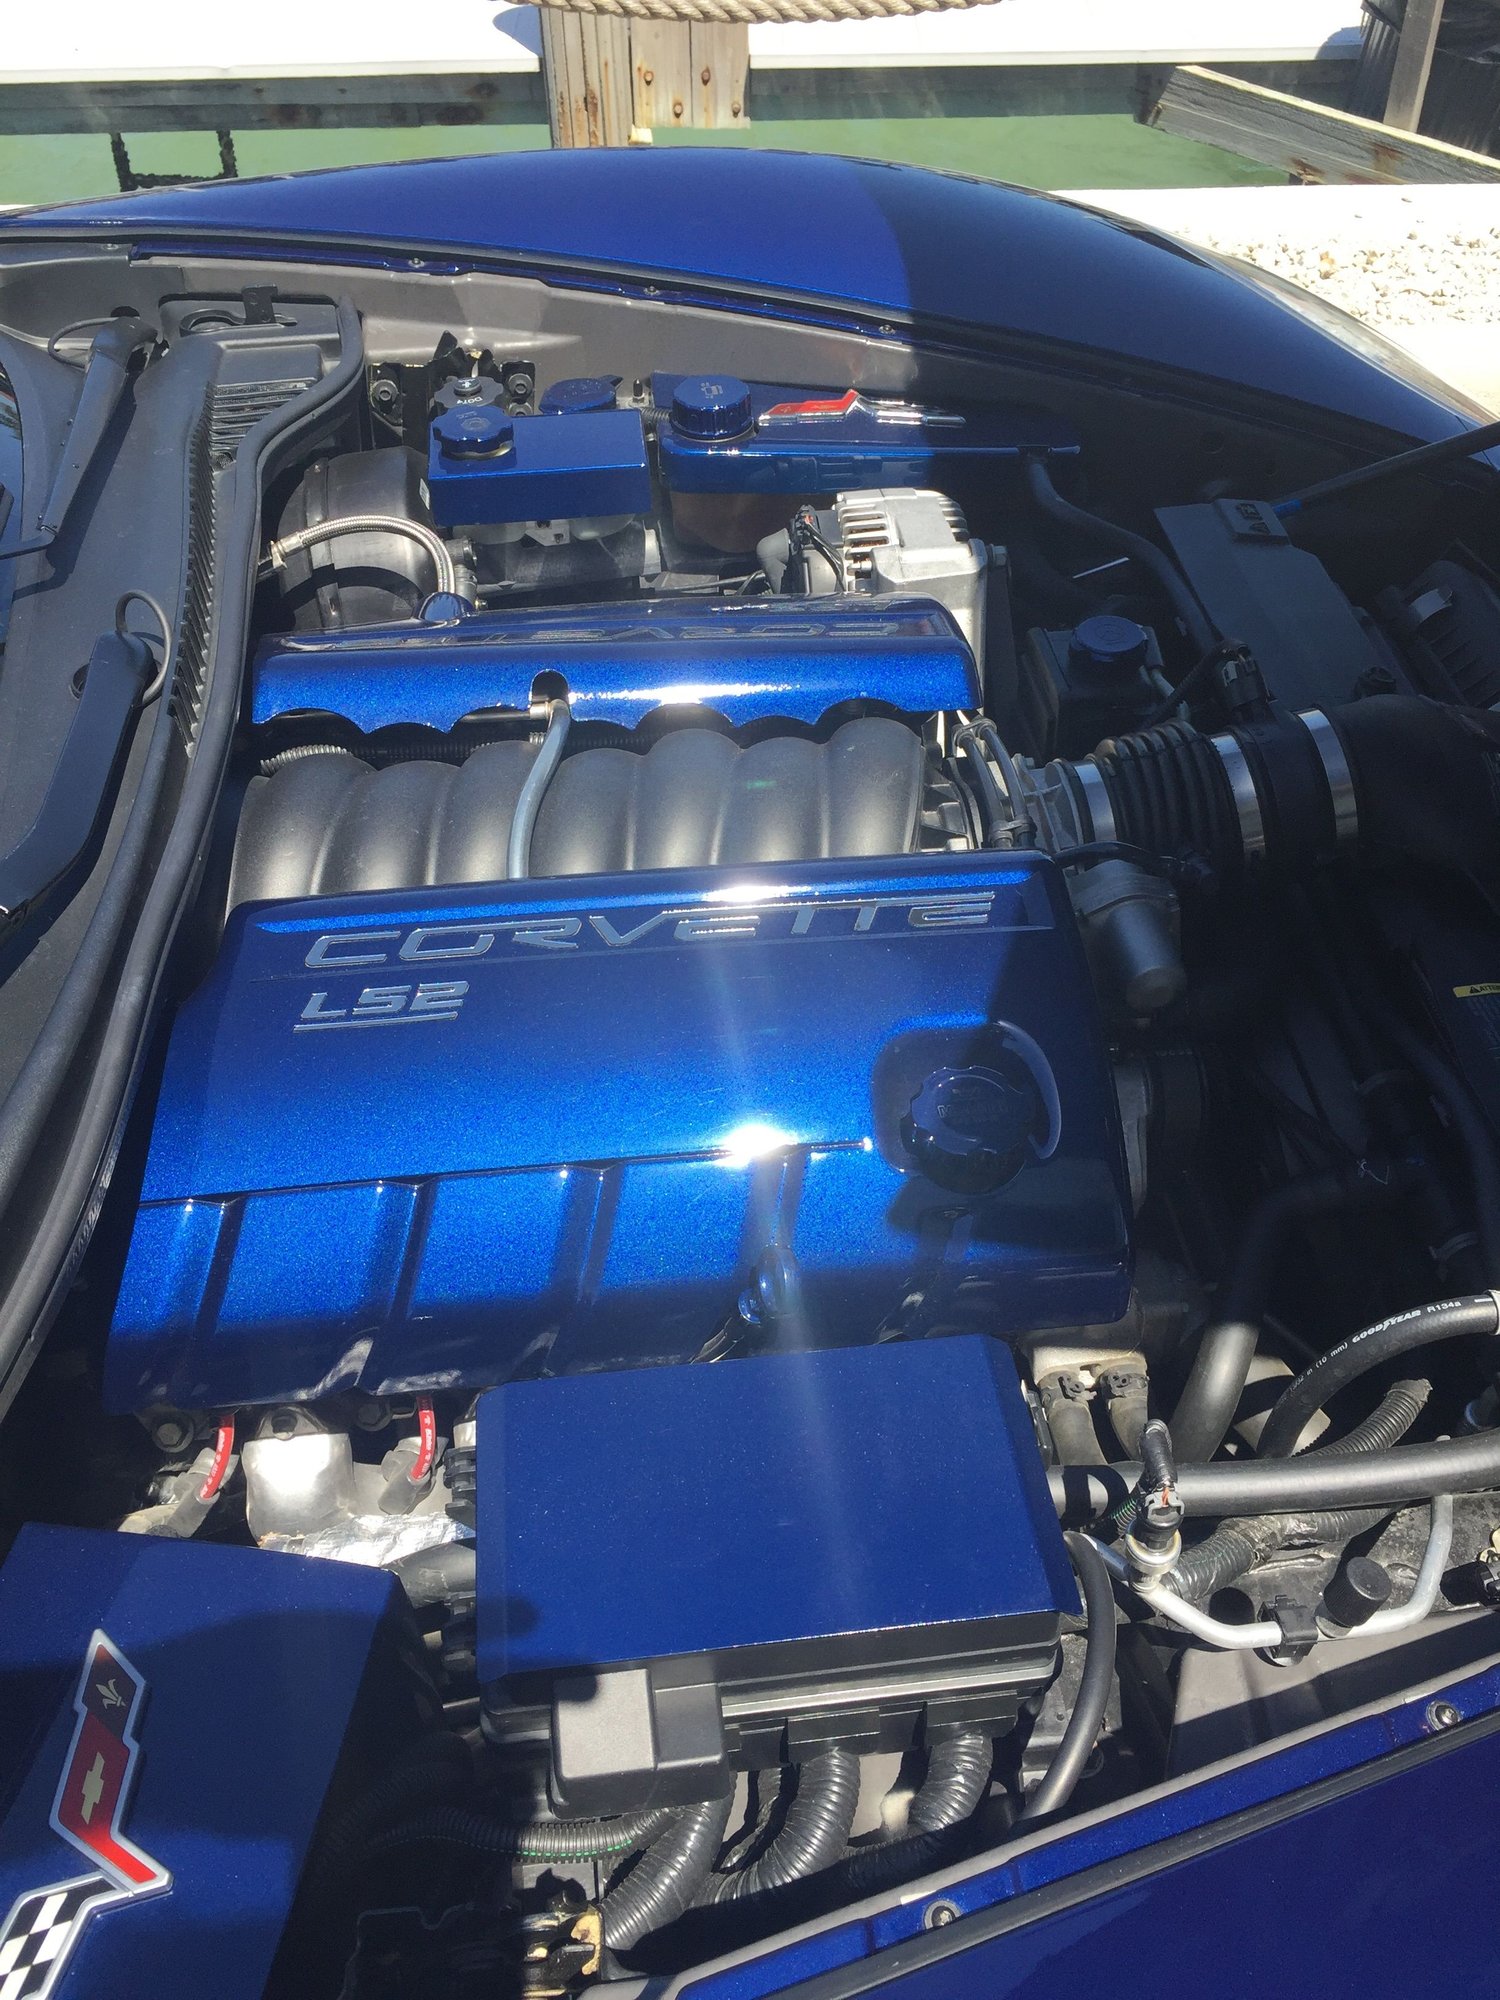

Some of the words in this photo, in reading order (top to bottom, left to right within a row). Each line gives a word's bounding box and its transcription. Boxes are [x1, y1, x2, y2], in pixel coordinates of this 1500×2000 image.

[304, 892, 995, 968] CORVETTE
[300, 980, 469, 1019] LS2
[1352, 1309, 1421, 1343] GOODYEAR
[1426, 1300, 1462, 1313] R134a
